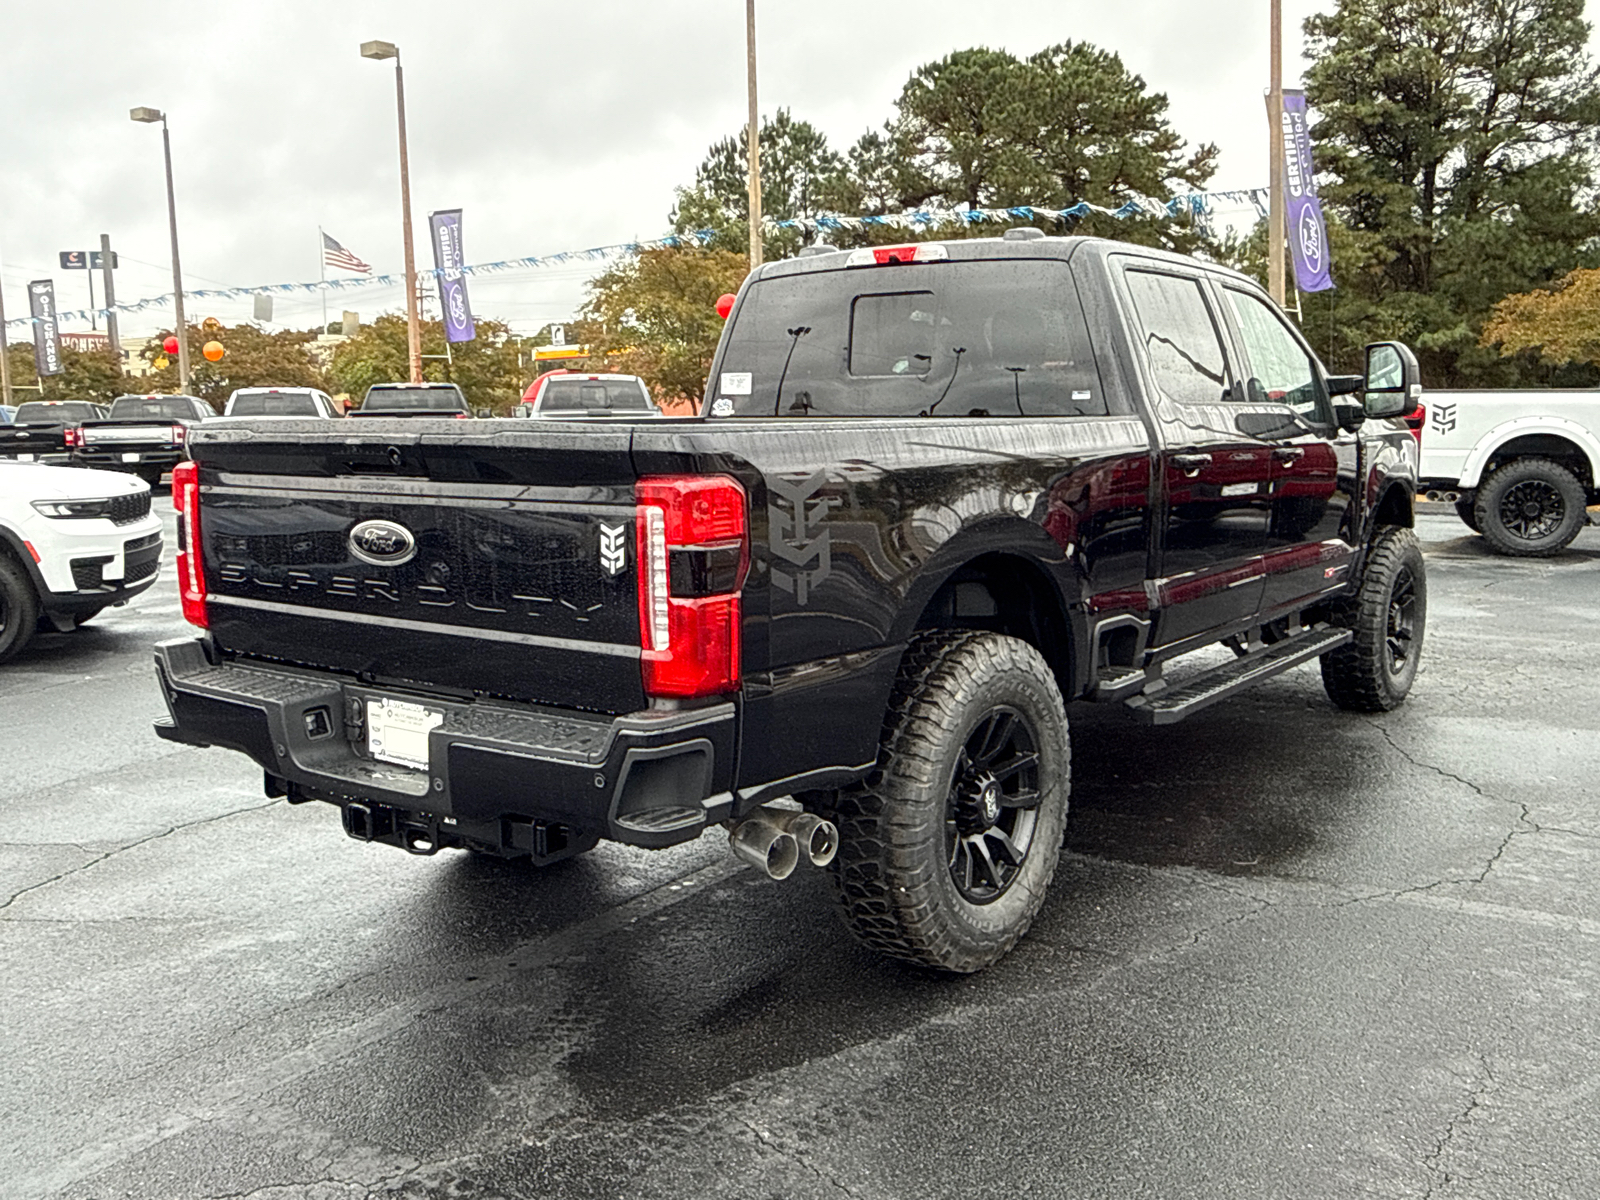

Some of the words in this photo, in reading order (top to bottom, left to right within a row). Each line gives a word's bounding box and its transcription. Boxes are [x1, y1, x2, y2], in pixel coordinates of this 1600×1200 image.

[1282, 111, 1302, 197] CERTIFIED
[440, 226, 454, 281] CRTIFIED
[1303, 218, 1319, 259] Ford
[452, 293, 465, 320] Ford
[44, 323, 57, 371] CHANGE
[362, 528, 396, 552] Ford
[221, 564, 400, 601] SUPER
[418, 585, 602, 621] DUTY
